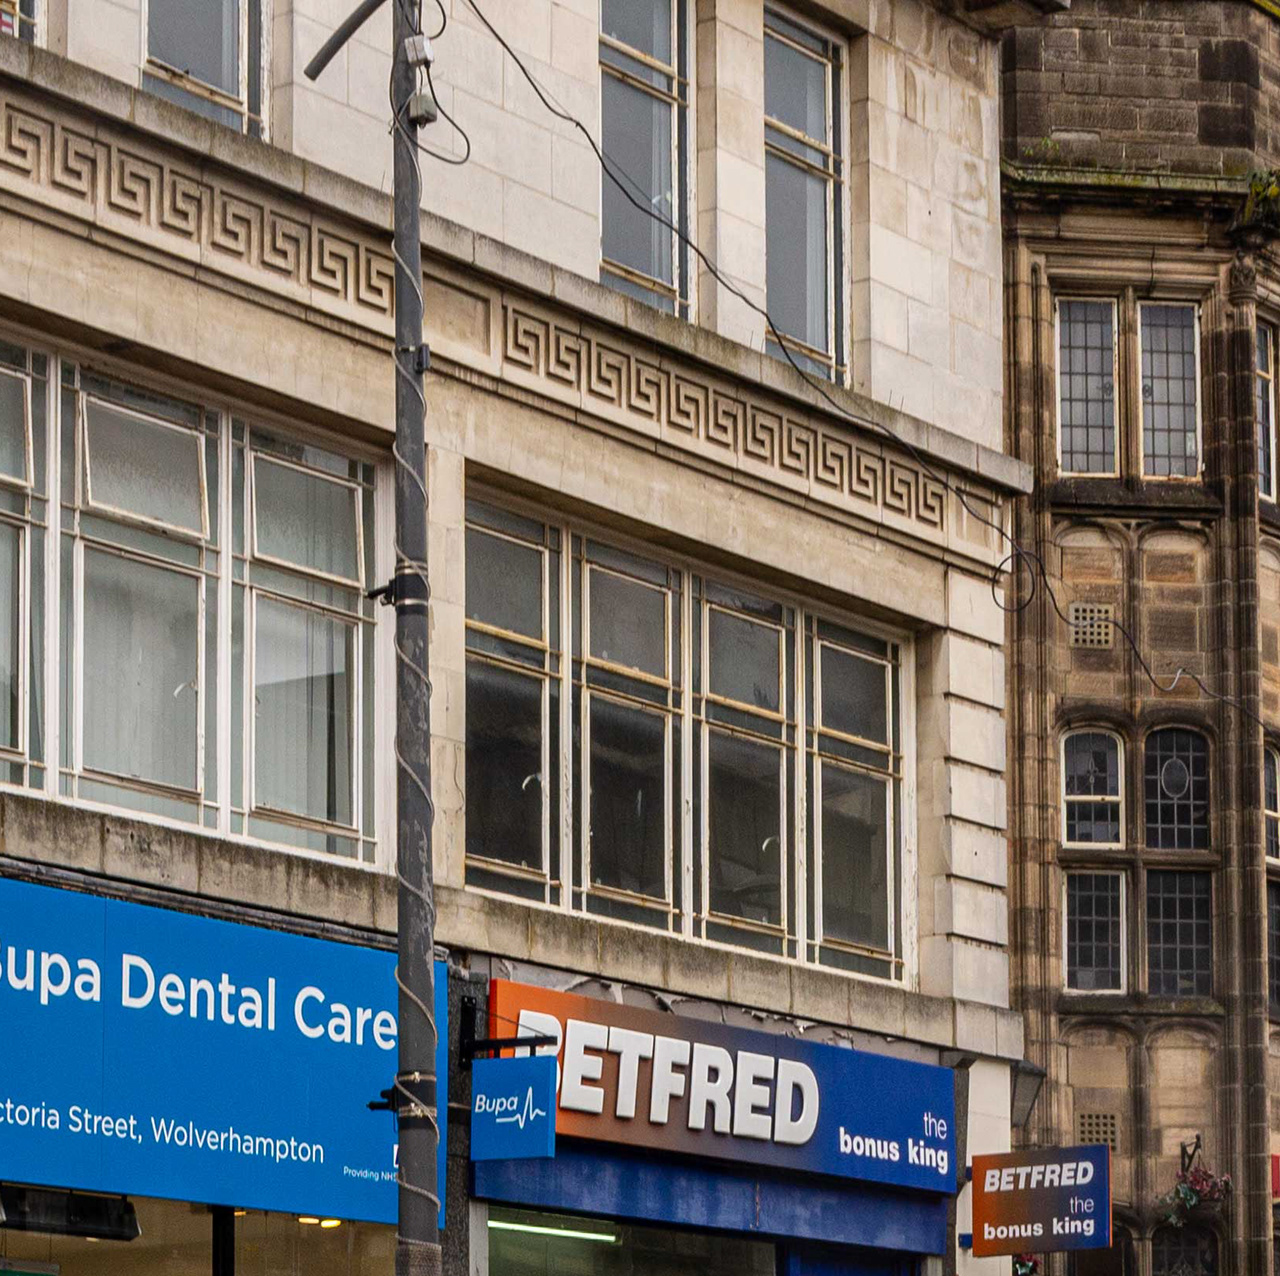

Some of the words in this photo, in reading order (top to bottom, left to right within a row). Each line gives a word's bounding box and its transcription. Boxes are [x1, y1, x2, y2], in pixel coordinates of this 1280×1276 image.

[122, 953, 276, 1031] Dental
[294, 986, 398, 1050] Care
[515, 1009, 819, 1146] BETFRED
[474, 1093, 519, 1115] Bupa
[68, 1106, 143, 1145] Street,
[151, 1117, 325, 1164] Wolverhampton
[923, 1111, 948, 1140] the
[838, 1126, 900, 1162] bonus
[908, 1138, 949, 1175] king
[343, 1166, 380, 1182] Providing
[984, 1161, 1095, 1193] BETFRED
[1070, 1197, 1095, 1214] the
[984, 1222, 1043, 1241] bonus
[1052, 1217, 1095, 1237] king
